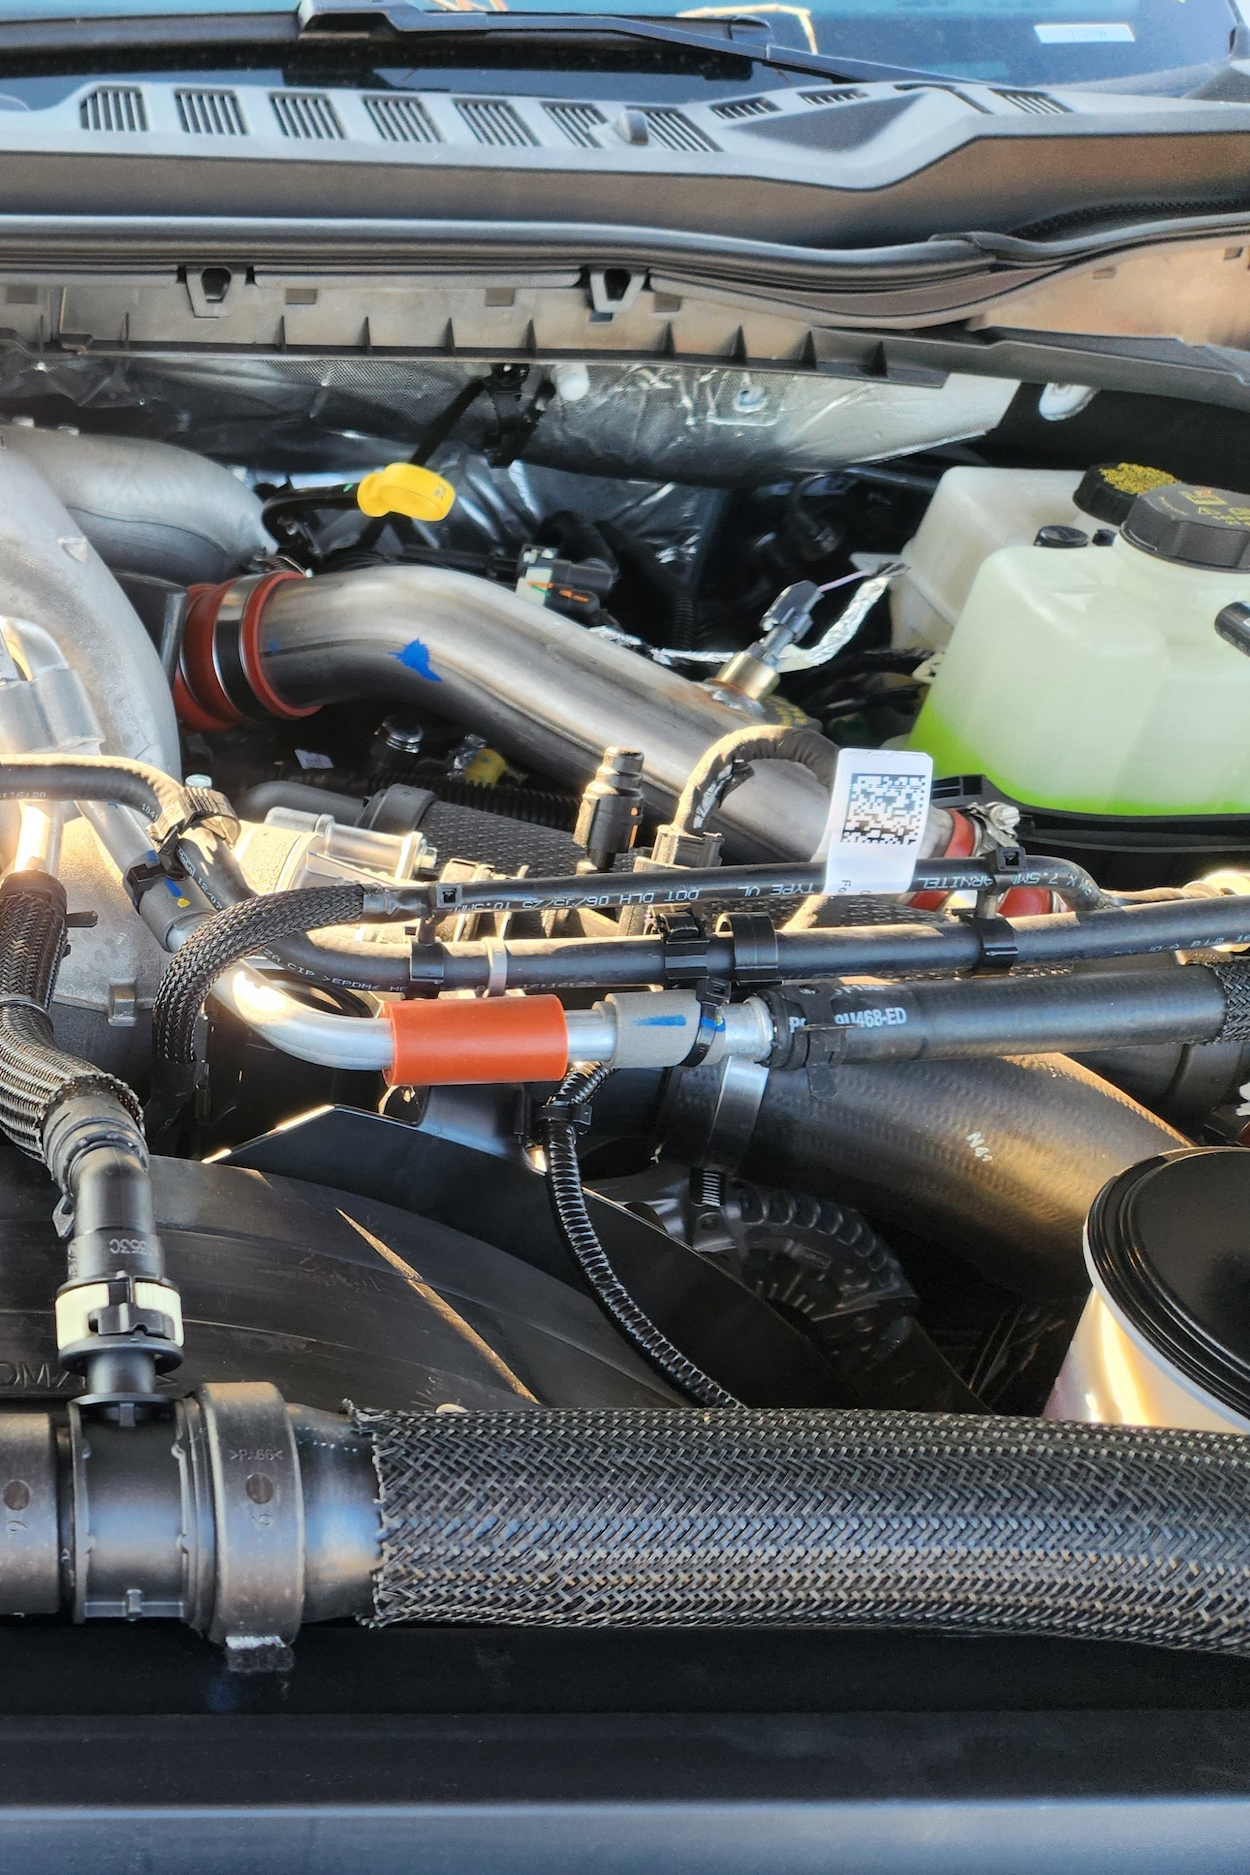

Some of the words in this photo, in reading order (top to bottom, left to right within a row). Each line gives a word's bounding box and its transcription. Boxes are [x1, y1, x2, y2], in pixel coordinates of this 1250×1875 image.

[769, 882, 815, 896] TYPE
[917, 876, 993, 889] ARNITEL
[620, 892, 654, 905] DLH
[664, 889, 699, 904] DOT
[322, 974, 381, 991] >EPDM<
